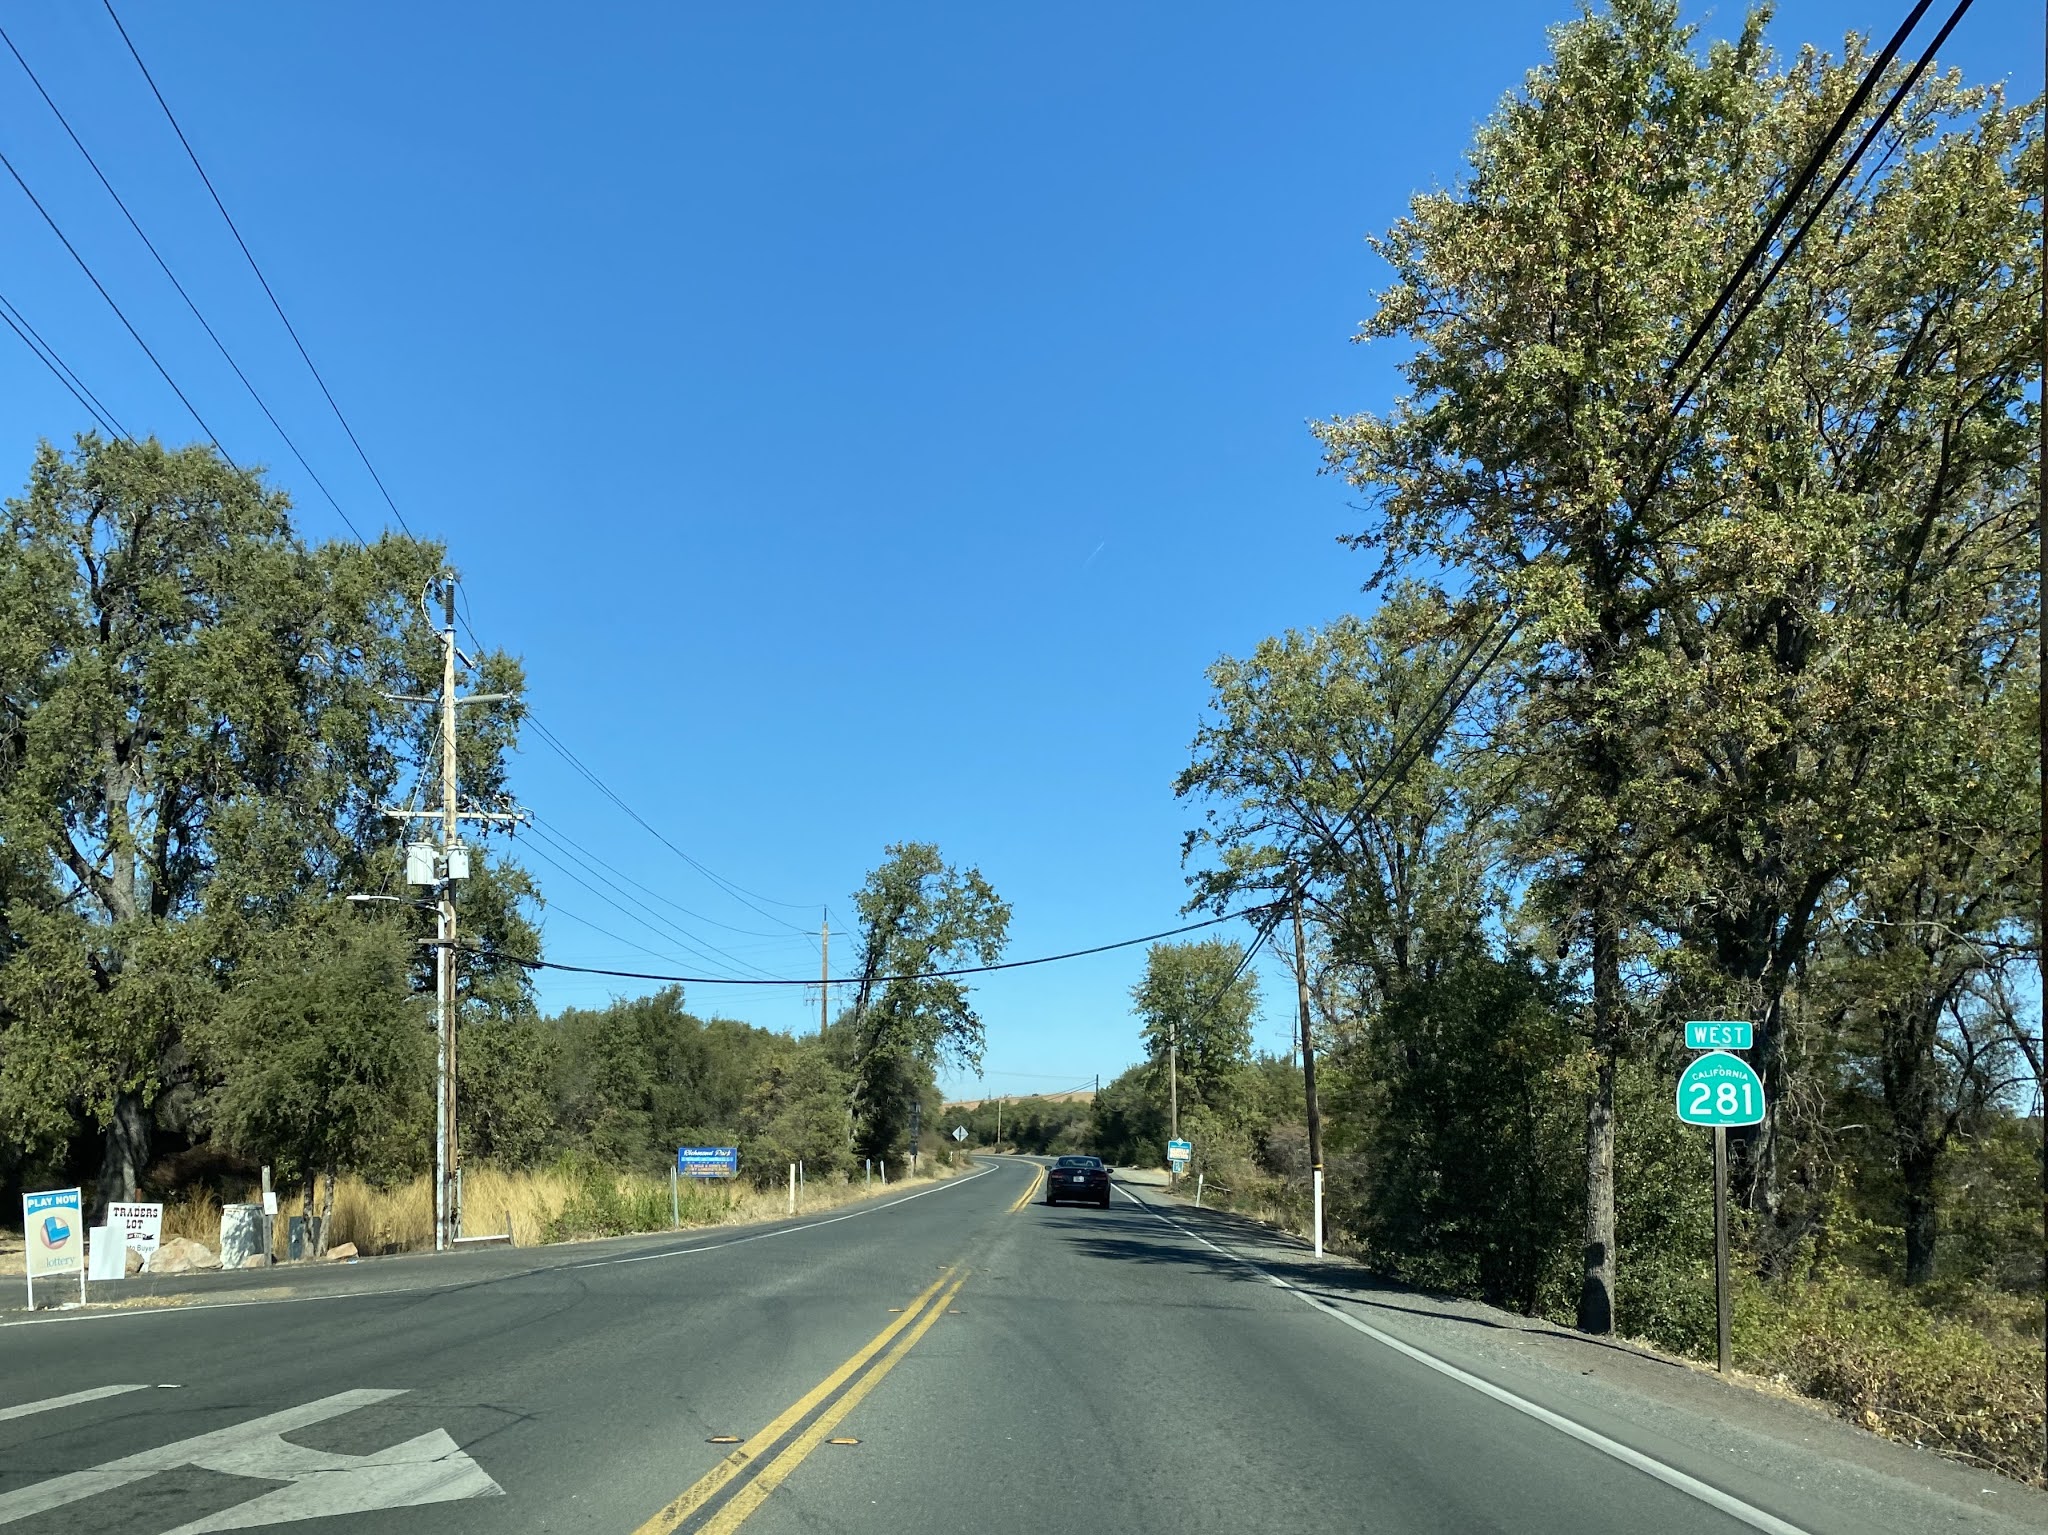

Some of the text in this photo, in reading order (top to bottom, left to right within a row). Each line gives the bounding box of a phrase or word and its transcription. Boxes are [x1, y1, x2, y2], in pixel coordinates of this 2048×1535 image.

[1694, 1026, 1744, 1044] WEST
[1692, 1068, 1749, 1081] CALIFORNIA
[1689, 1082, 1753, 1116] 281
[28, 1194, 78, 1208] PLAY NOW
[113, 1207, 159, 1218] TRADERS
[126, 1219, 144, 1230] LOT
[136, 1244, 155, 1253] Buyer
[46, 1257, 75, 1267] lottery
